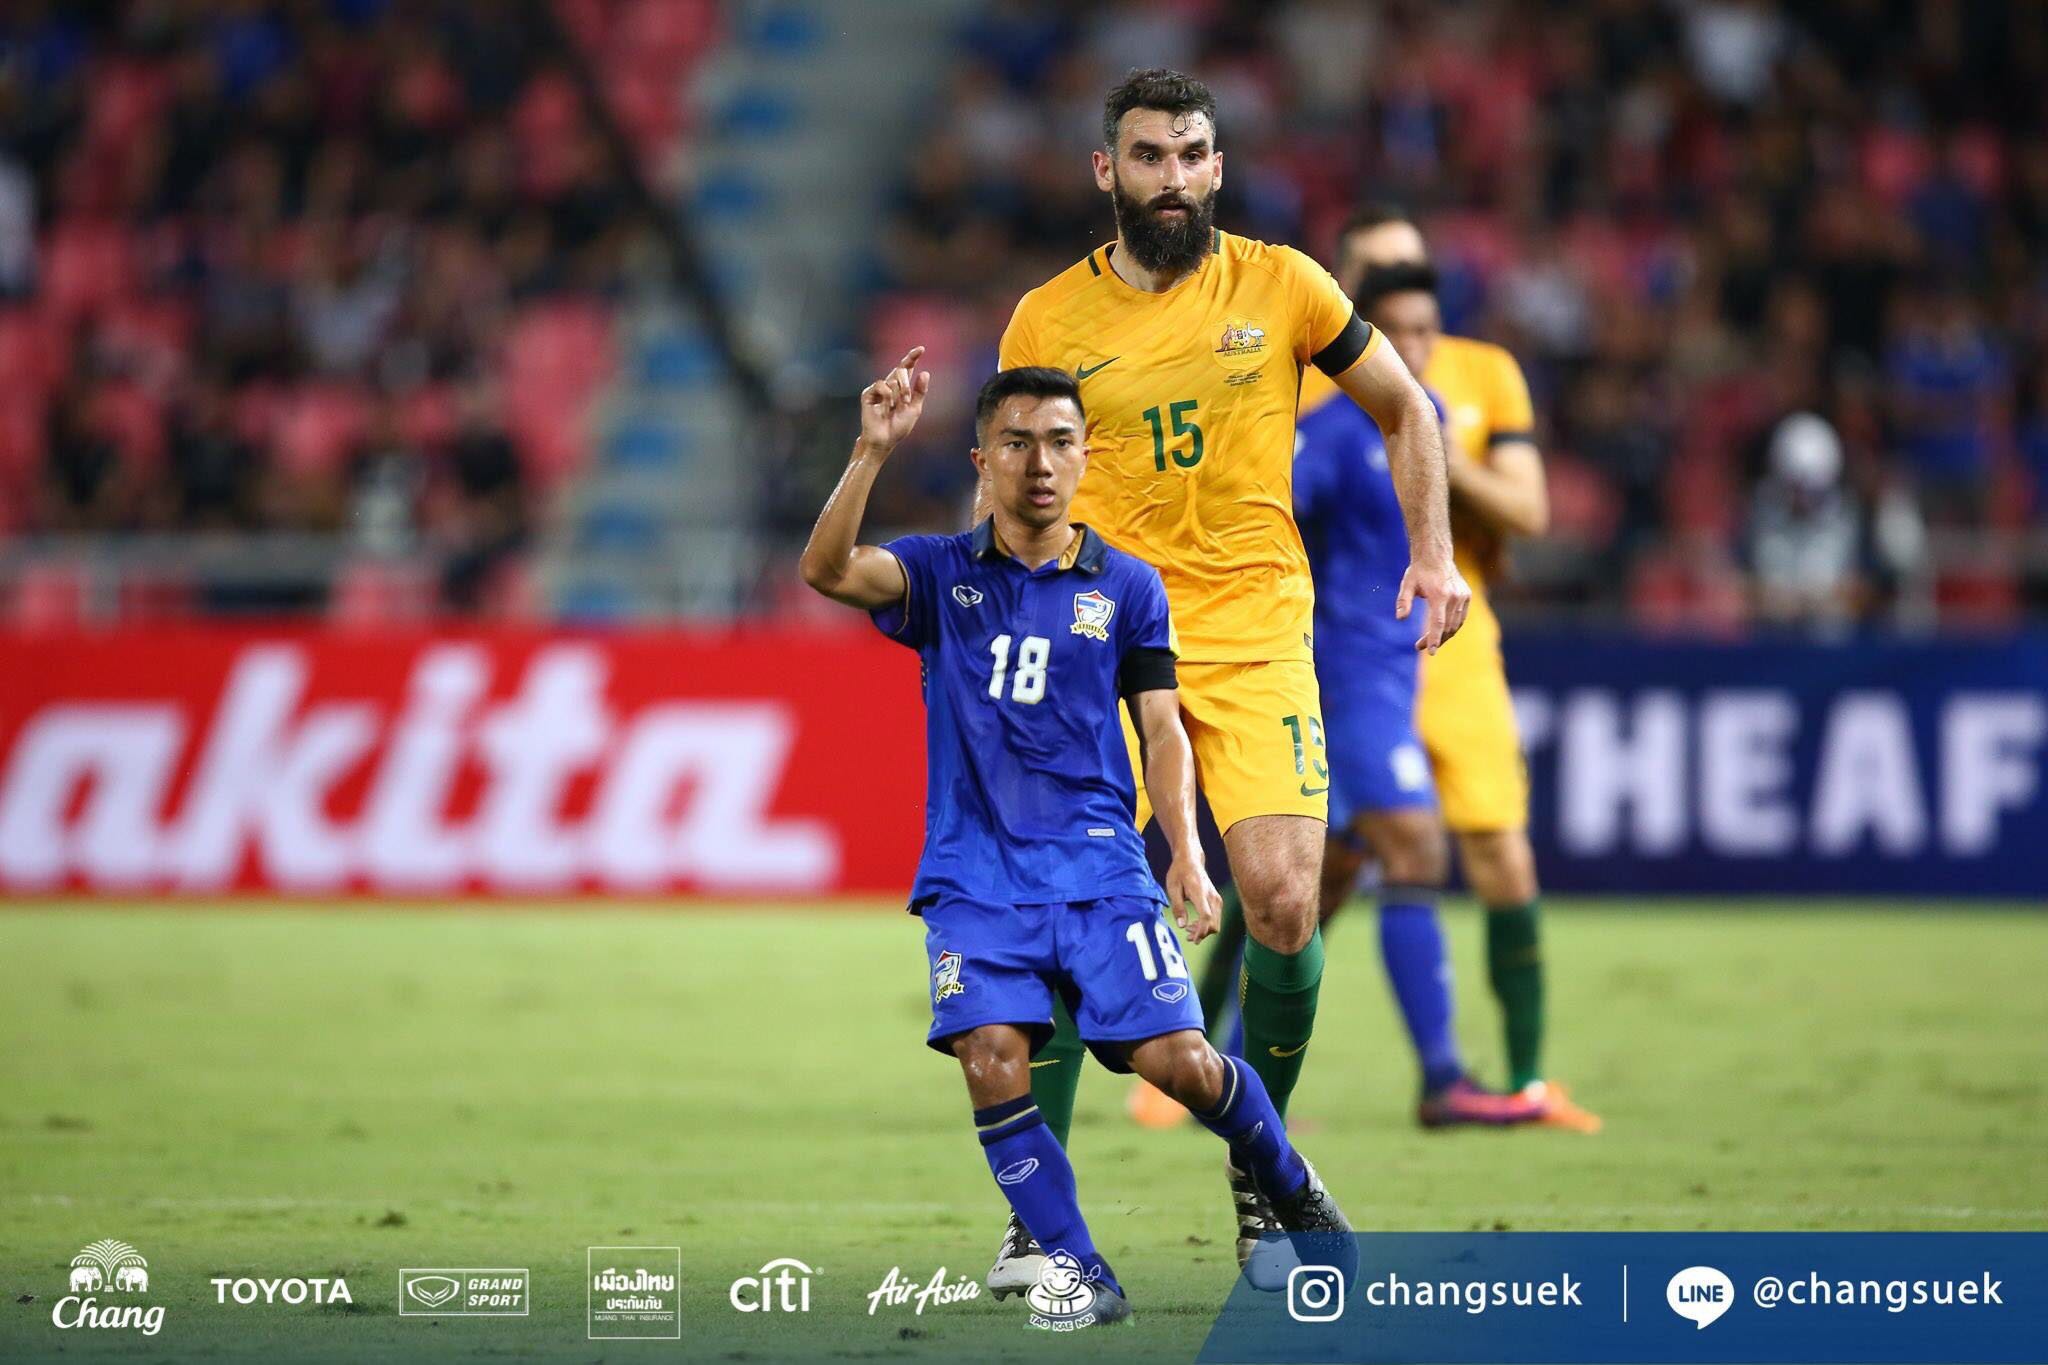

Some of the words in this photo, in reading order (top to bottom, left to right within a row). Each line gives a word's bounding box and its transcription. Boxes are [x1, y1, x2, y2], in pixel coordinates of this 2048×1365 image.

[1223, 347, 1261, 357] AUSTRALIA
[1143, 400, 1203, 472] 15
[988, 634, 1050, 705] 18
[0, 640, 838, 888] akita
[1126, 921, 1188, 981] 18
